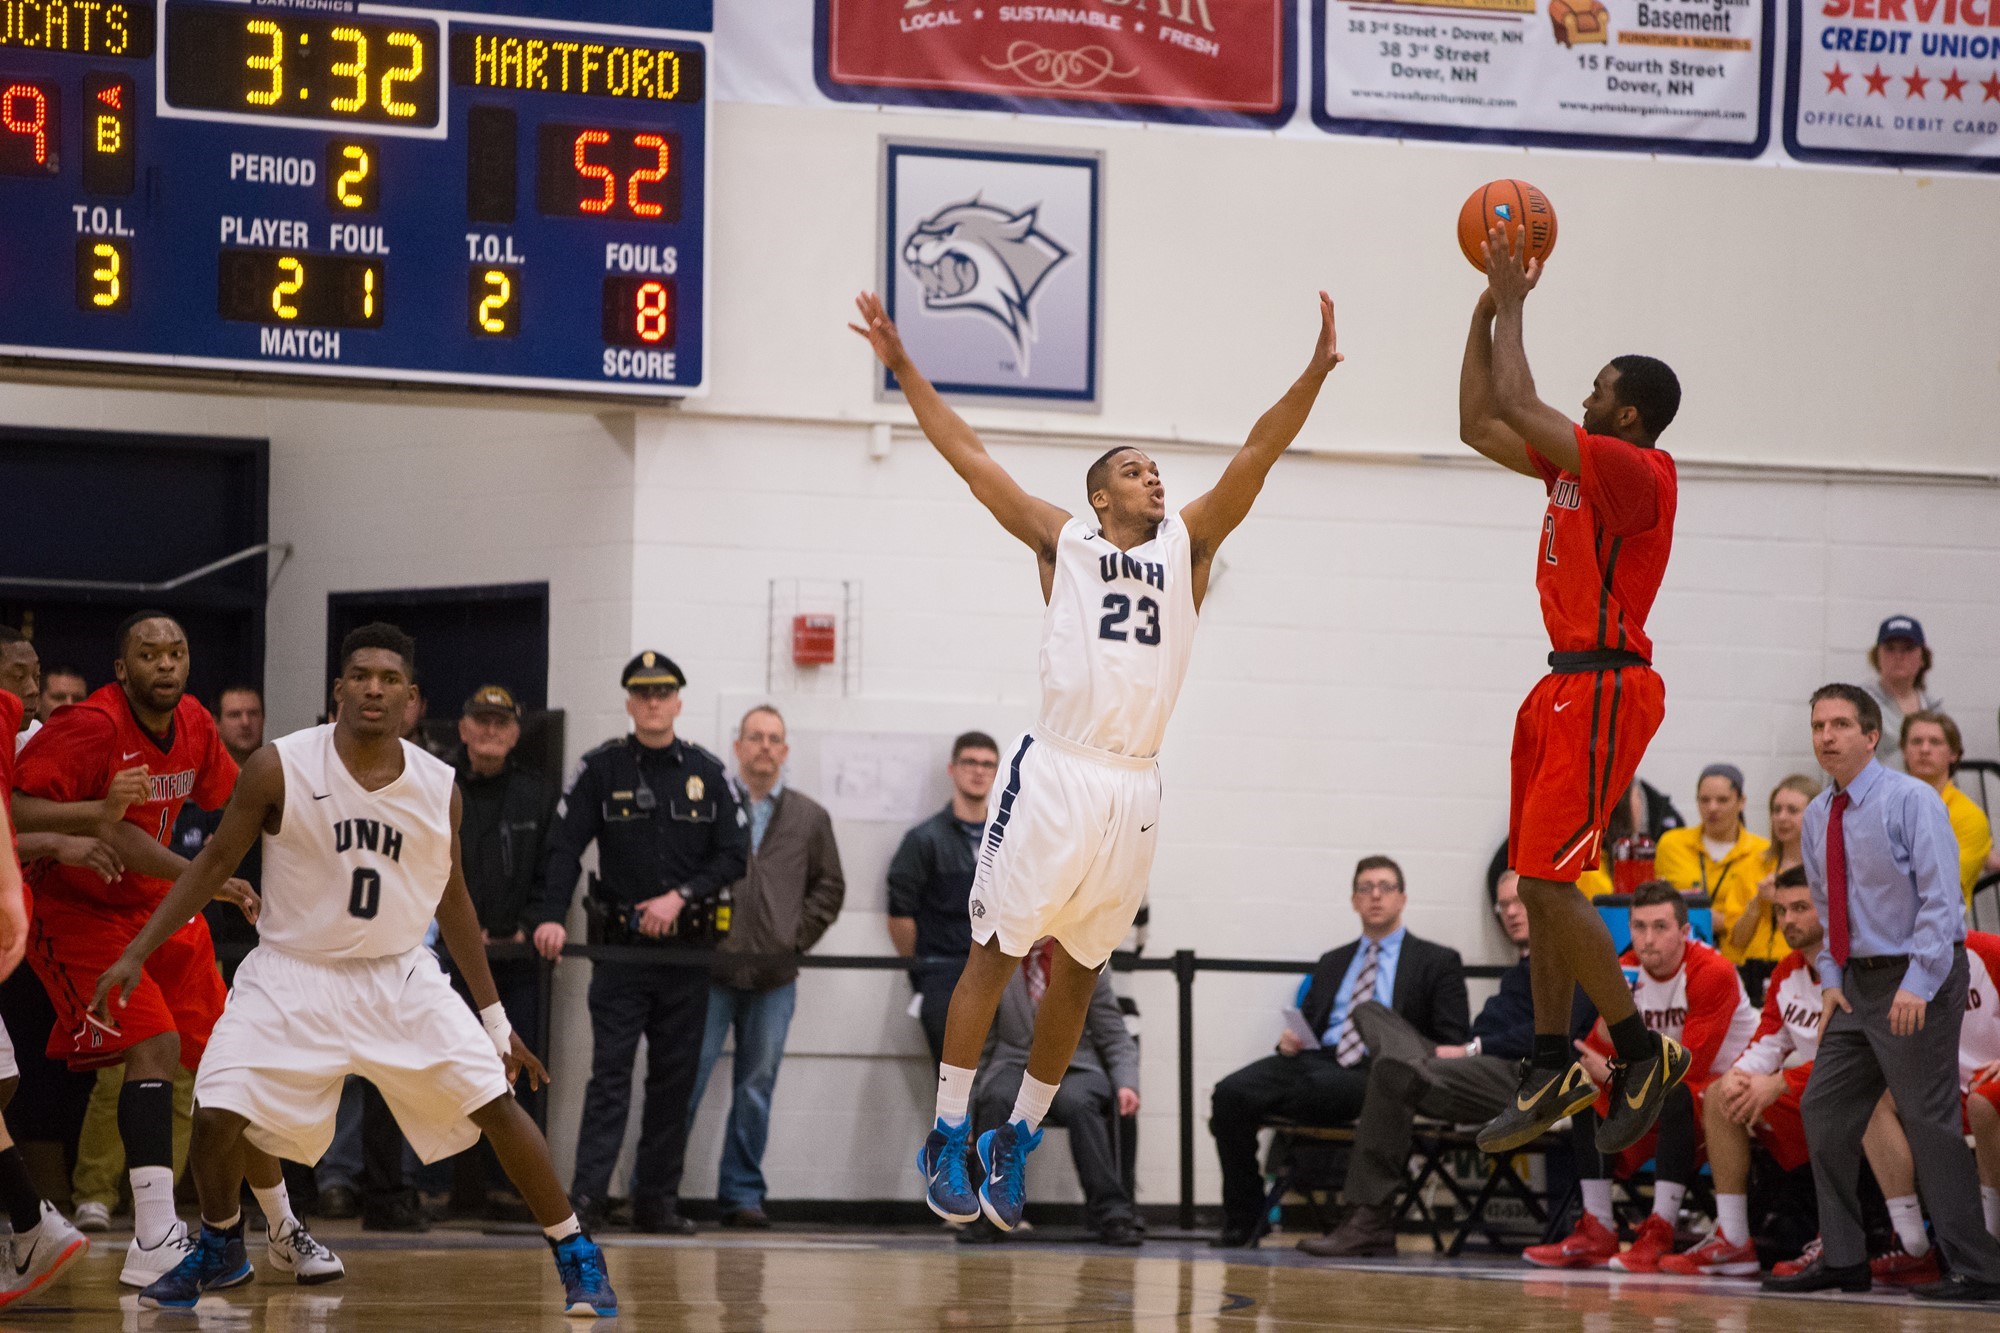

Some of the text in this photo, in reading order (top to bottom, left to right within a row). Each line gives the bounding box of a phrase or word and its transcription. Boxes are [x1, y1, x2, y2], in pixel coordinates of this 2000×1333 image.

[900, 10, 961, 32] LOCAL
[999, 6, 1122, 30] SUSTAINABLE
[1158, 26, 1219, 57] FRESH
[1393, 21, 1437, 38] Street
[1452, 27, 1498, 43] Dover,
[1502, 31, 1523, 43] NH
[1638, 3, 1731, 33] Basement
[1380, 41, 1401, 57] 38
[1434, 45, 1490, 64] Street
[1821, 26, 1912, 54] CREDIT
[246, 20, 422, 117] 3:32
[475, 35, 679, 99] HARTFORD
[1391, 62, 1478, 82] Dover, NH
[1578, 54, 1725, 78] 15 Fourth Street
[1607, 77, 1694, 97] Dover, NH
[1804, 110, 1999, 135] OFFICIAL DEBIT CARD
[230, 153, 316, 186] PERIOD
[337, 145, 368, 207] 2
[574, 130, 669, 217] 52
[72, 205, 135, 236] T.O.L.
[220, 216, 390, 254] PLAYER FOUL
[465, 234, 525, 263] T.O.L.
[605, 243, 677, 274] FOULS
[94, 244, 119, 306] 3
[272, 257, 373, 319] 2 1
[479, 271, 510, 332] 2
[636, 281, 667, 343] 8
[260, 327, 340, 358] MATCH
[602, 349, 676, 379] SCORE
[1545, 512, 1558, 566] 2
[1099, 551, 1164, 592] UNH
[1098, 592, 1162, 647] 23
[333, 818, 403, 864] UNH
[347, 866, 381, 921] 0
